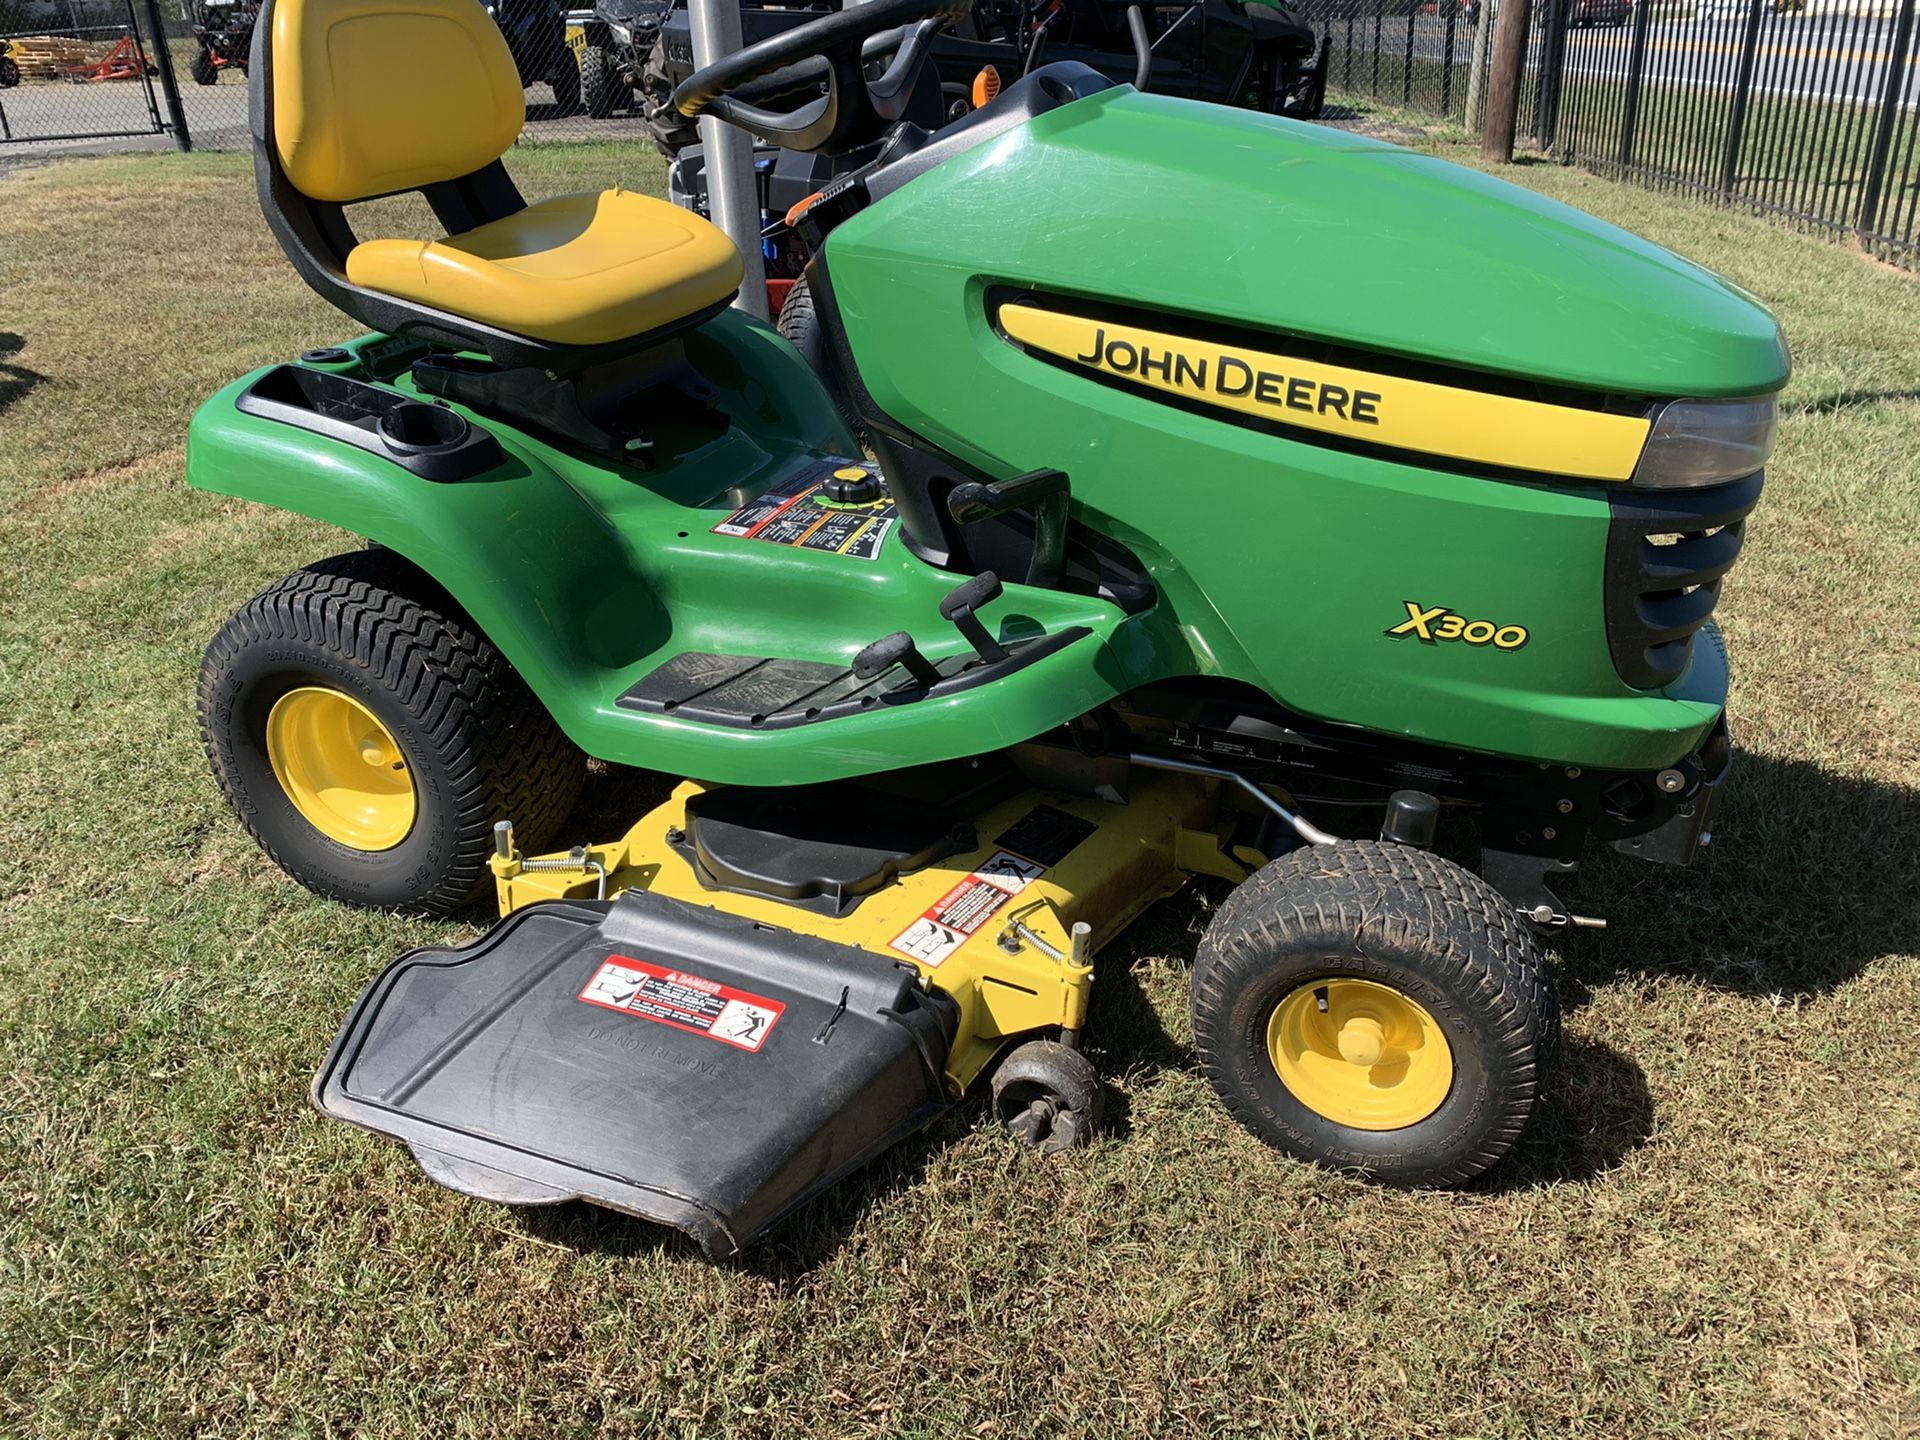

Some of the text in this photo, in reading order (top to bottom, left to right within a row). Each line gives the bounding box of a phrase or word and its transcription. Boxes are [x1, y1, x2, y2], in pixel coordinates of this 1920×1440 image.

[1077, 329, 1382, 425] JOHN DEERE
[1383, 600, 1531, 652] X300
[941, 881, 973, 908] DANGER
[678, 974, 722, 994] DANGER
[1321, 955, 1474, 1034] CARLISLE
[587, 1028, 722, 1077] DO NOT REMOVE
